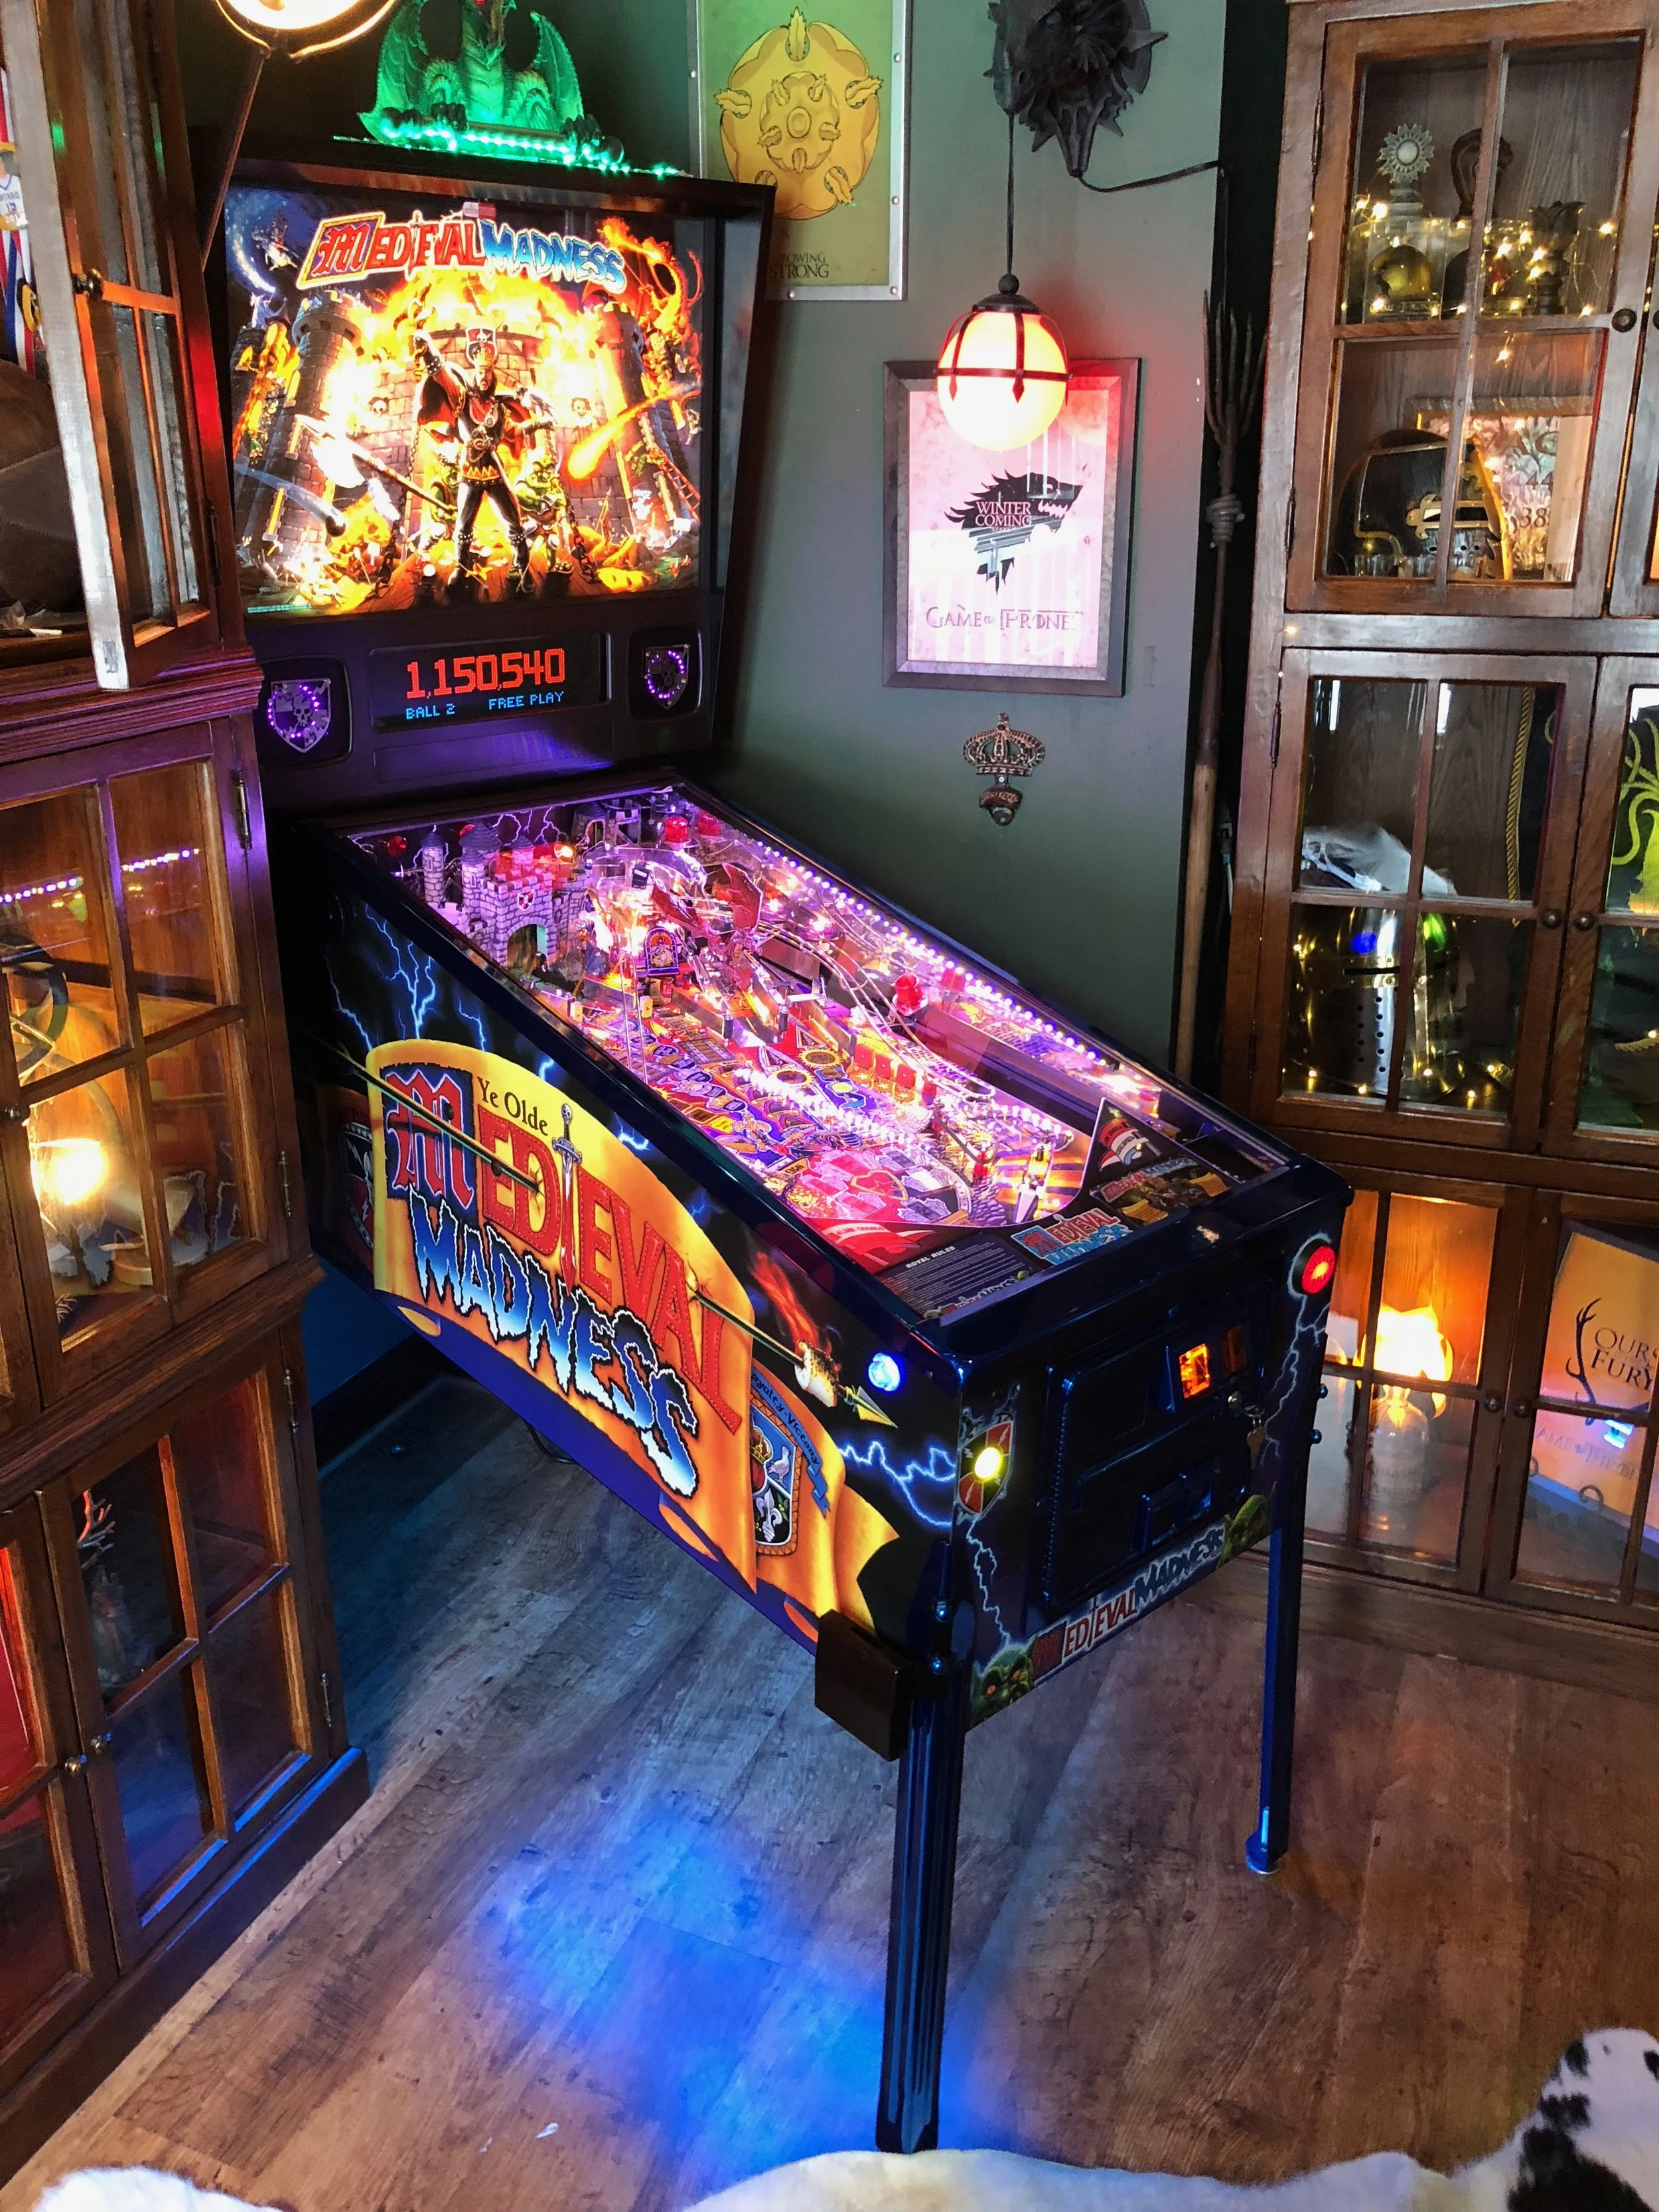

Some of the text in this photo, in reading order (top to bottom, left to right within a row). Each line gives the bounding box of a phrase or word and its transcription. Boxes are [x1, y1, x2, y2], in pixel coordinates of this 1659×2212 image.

[312, 211, 626, 292] MEDIEVAL MADNESS
[769, 263, 830, 279] STRONG
[975, 501, 1031, 515] WINTER
[975, 514, 1032, 526] COMING
[926, 605, 982, 628] GAME
[406, 648, 565, 699] 1,150,540
[406, 703, 456, 719] BALL 2
[488, 690, 565, 710] FREE PLAY
[476, 1076, 548, 1136] Ye Olde
[384, 1069, 742, 1435] MEDIEVAL
[905, 1245, 956, 1269] ROYAL RULES
[409, 1186, 699, 1499] MADNESS
[1591, 1348, 1654, 1392] FURY
[751, 1373, 820, 1465] oyalty-Victory
[1033, 1526, 1225, 1683] MEDIEVAL MADNESS
